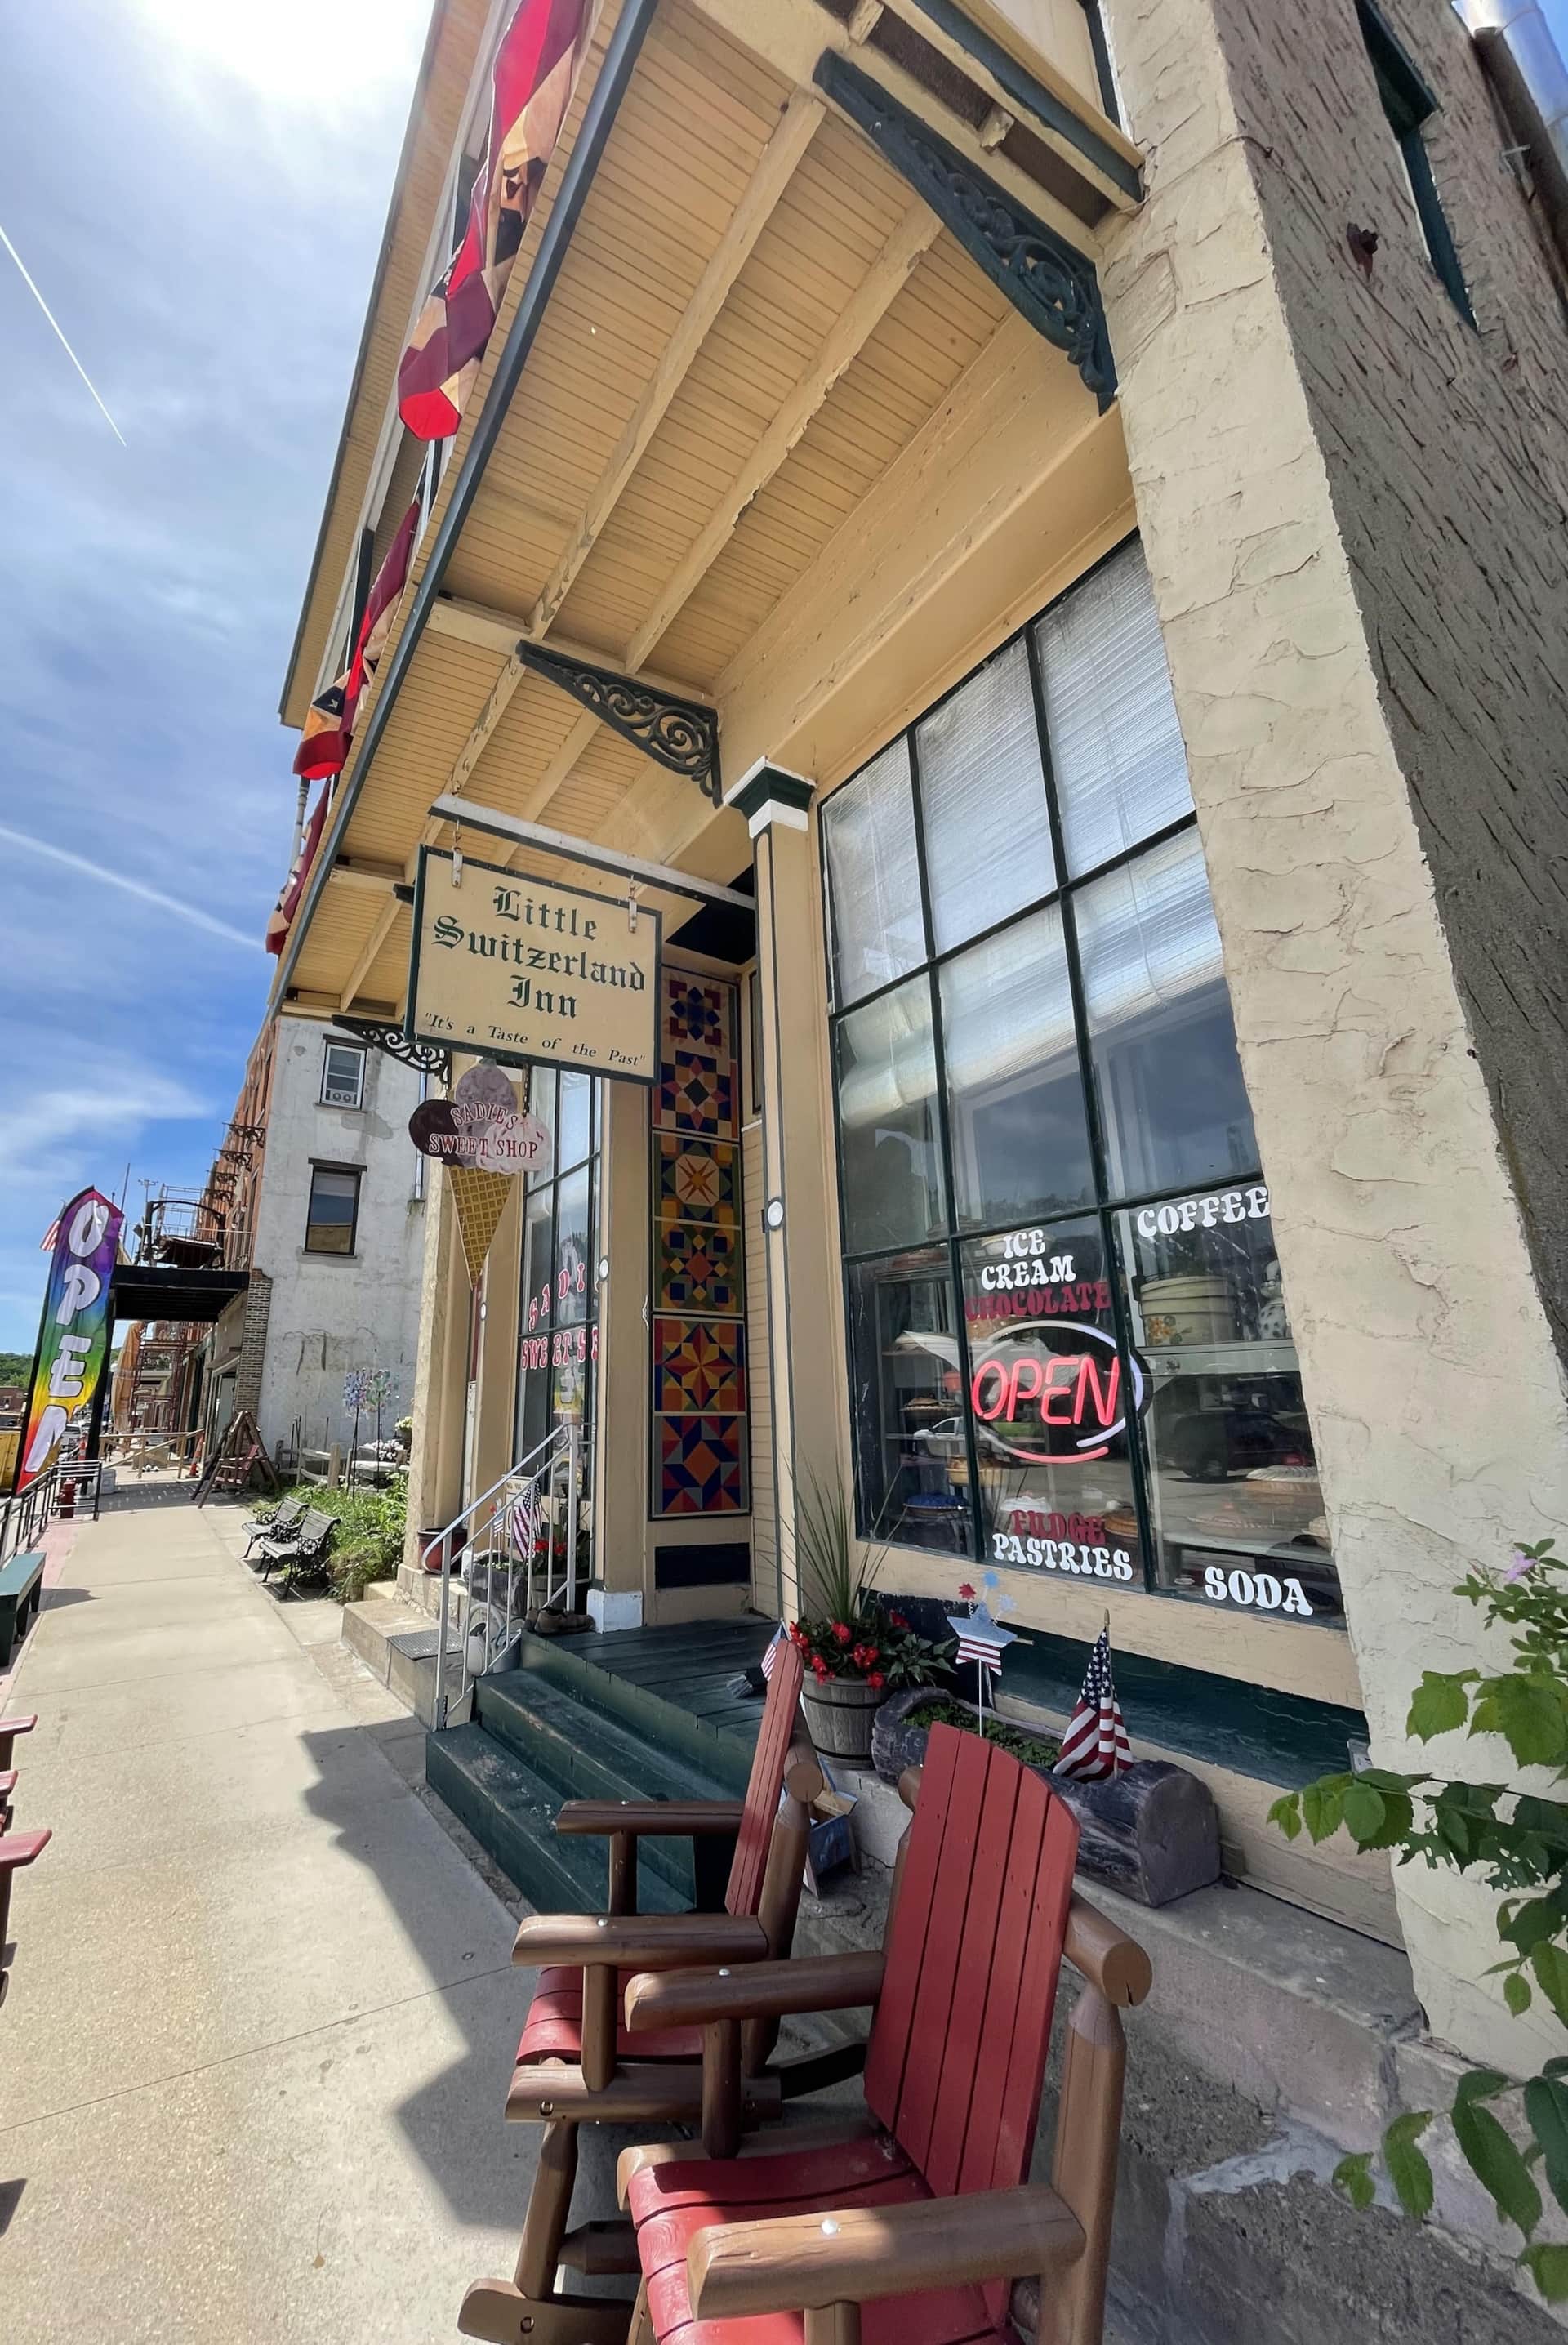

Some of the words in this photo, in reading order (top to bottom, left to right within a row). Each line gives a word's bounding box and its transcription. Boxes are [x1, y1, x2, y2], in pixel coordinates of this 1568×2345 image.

[493, 885, 597, 941] Little
[431, 915, 645, 992] Switzerland
[506, 974, 577, 1019] Inn
[466, 1025, 475, 1035] a
[488, 1025, 528, 1045] Taste
[541, 1037, 562, 1050] of
[572, 1043, 597, 1059] the
[429, 1133, 489, 1157] SWEET
[496, 1139, 538, 1158] SHOP
[1137, 1186, 1272, 1237] COFFEE
[1004, 1228, 1046, 1259] ICE
[981, 1255, 1077, 1291] CREAM
[965, 1281, 1112, 1321] CHOCOLATE
[972, 1355, 1120, 1426] OPEN
[1011, 1509, 1106, 1545] FUDGE
[992, 1532, 1134, 1581] PASTRIES
[1205, 1566, 1313, 1616] SODA
